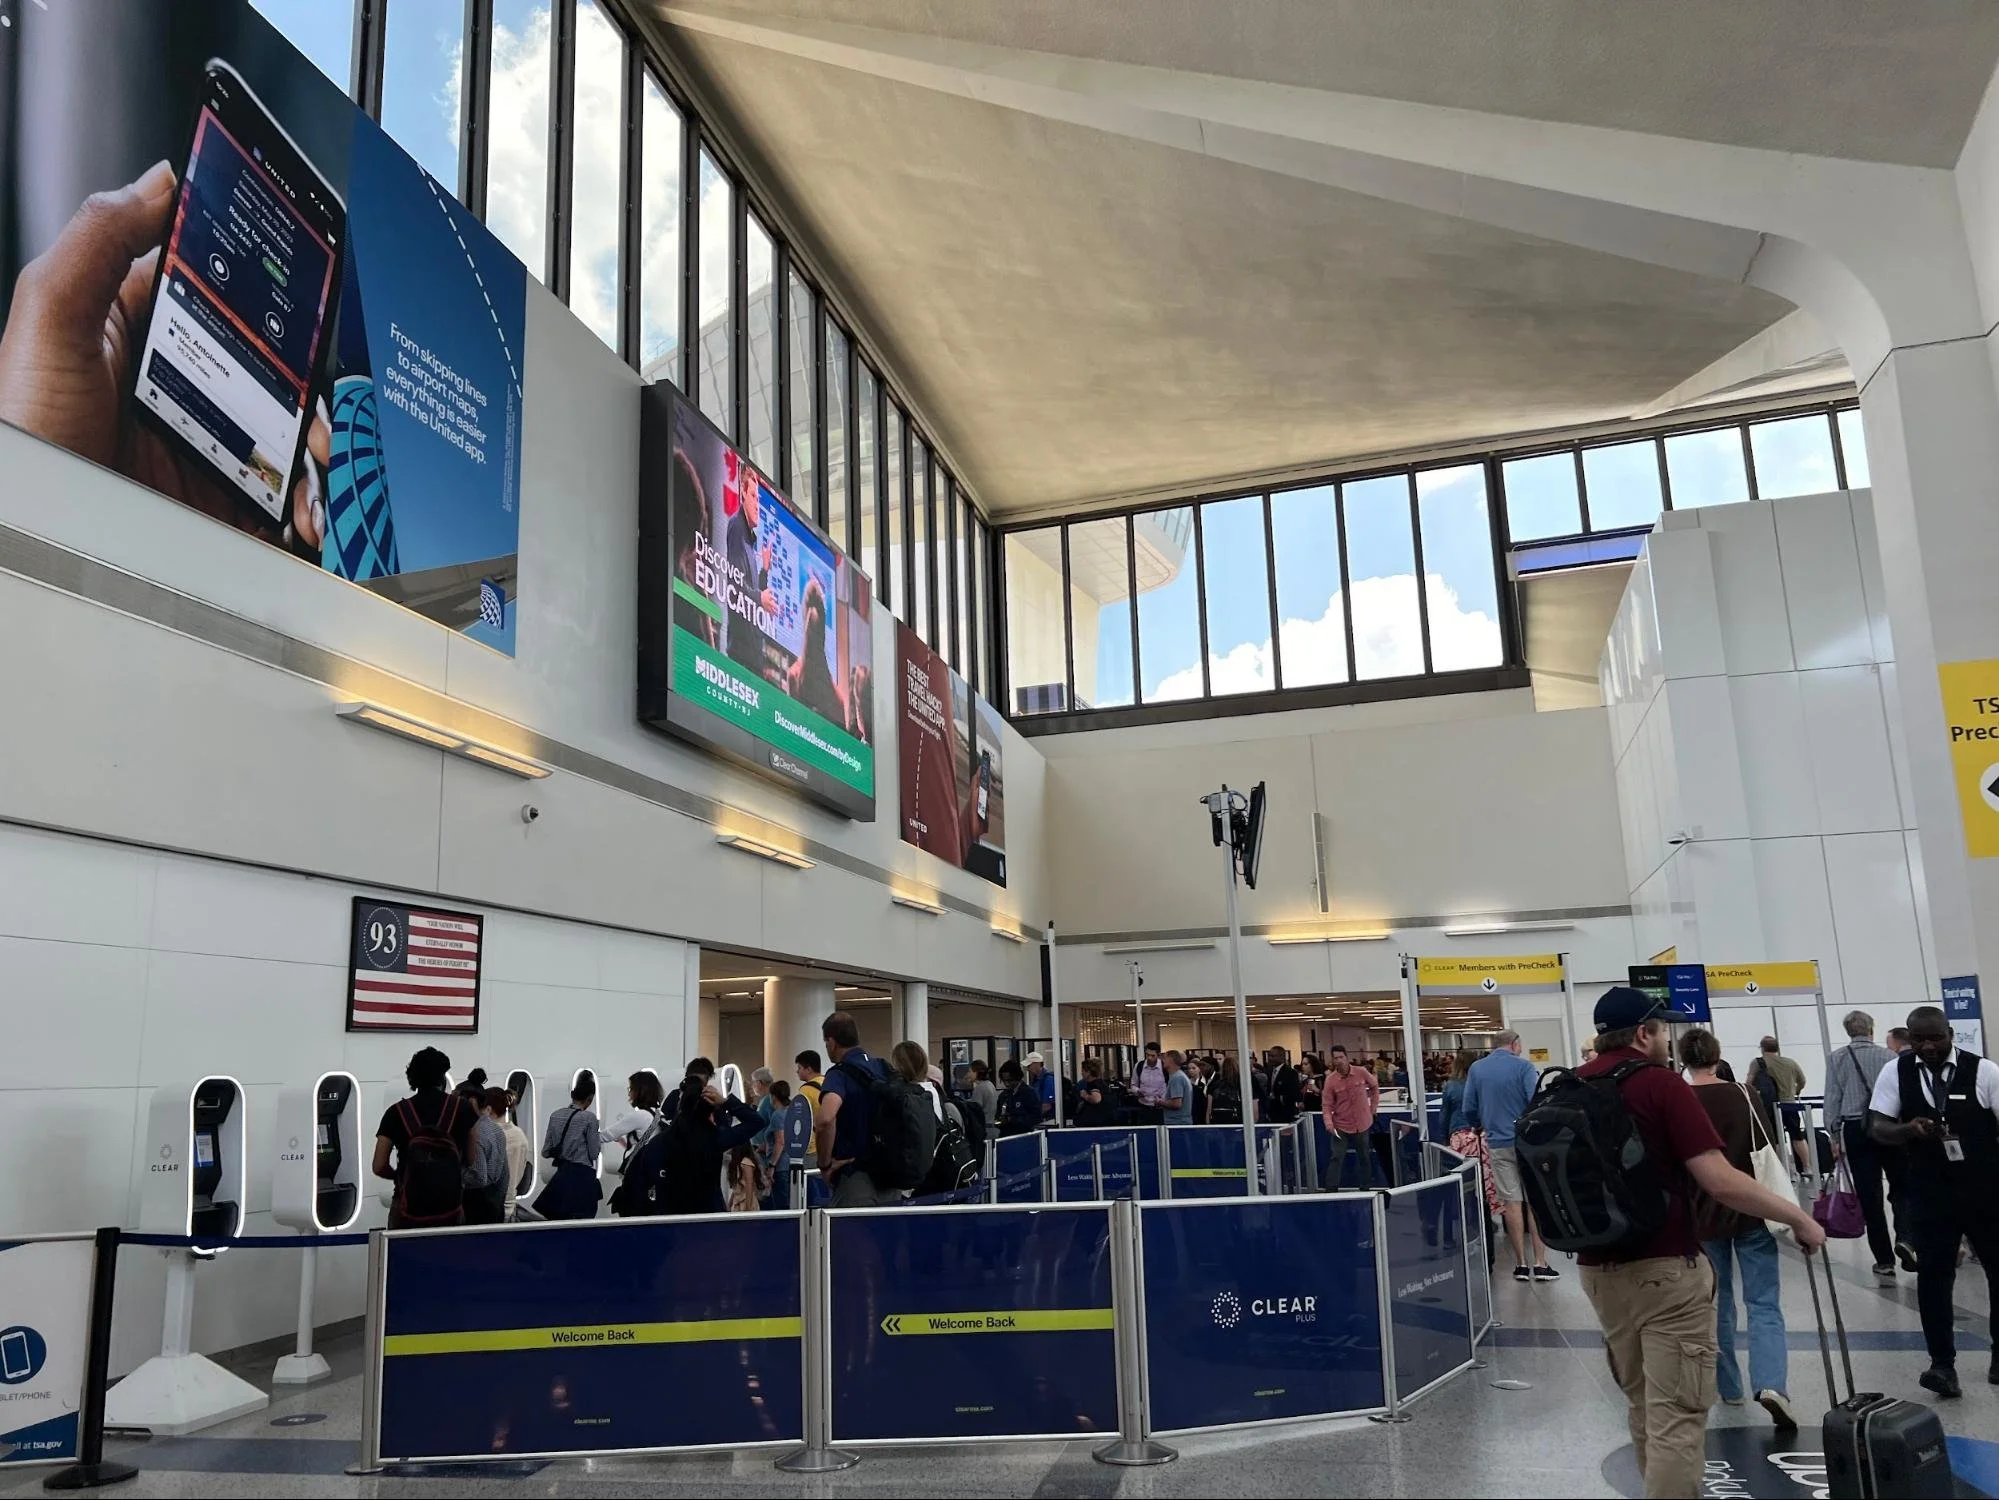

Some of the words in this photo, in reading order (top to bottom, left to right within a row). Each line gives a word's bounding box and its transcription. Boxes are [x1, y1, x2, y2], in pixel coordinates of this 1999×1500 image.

[264, 159, 296, 200] UNITED
[227, 203, 251, 234] Ready
[250, 228, 261, 245] for
[261, 240, 290, 277] check-in
[169, 315, 192, 342] Hello,
[192, 337, 230, 379] Antoinette
[178, 335, 201, 362] Member
[196, 362, 211, 380] miles
[390, 322, 420, 356] From
[421, 349, 464, 393] skipping
[465, 378, 487, 407] lines
[397, 350, 410, 370] to
[411, 364, 447, 398] airport
[449, 390, 479, 423] maps,
[386, 366, 446, 419] everything
[446, 407, 455, 423] is
[456, 416, 487, 444] easier
[384, 385, 408, 413] with
[410, 401, 429, 425] the
[430, 413, 464, 449] United
[465, 440, 487, 465] app.
[695, 530, 744, 587] Discover
[695, 558, 776, 640] EDUCATION
[695, 655, 760, 710] MIDDLESEX
[906, 658, 917, 679] THE
[917, 667, 930, 689] BEST
[906, 674, 926, 702] TRAVEL
[926, 689, 943, 714] HACK?
[907, 689, 917, 710] THE
[917, 698, 936, 724] UNITED
[774, 710, 862, 773] DiscoverMiddlesex.com/byDesign
[791, 762, 809, 780] Channel
[909, 818, 928, 833] UNITED
[369, 921, 397, 954] 93
[1458, 963, 1496, 972] Members
[1498, 962, 1517, 971] with
[1518, 960, 1556, 970] PreCheck
[151, 1164, 179, 1172] CLEAR
[281, 1153, 305, 1161] CLEAR
[928, 1317, 983, 1329] Welcome
[986, 1316, 1016, 1328] Back
[1251, 1296, 1316, 1316] CLEAR
[1295, 1314, 1316, 1323] PLUS
[551, 1331, 605, 1343] Welcome
[607, 1329, 635, 1340] Back
[22, 1442, 31, 1450] at
[33, 1441, 63, 1450] tsa.gov
